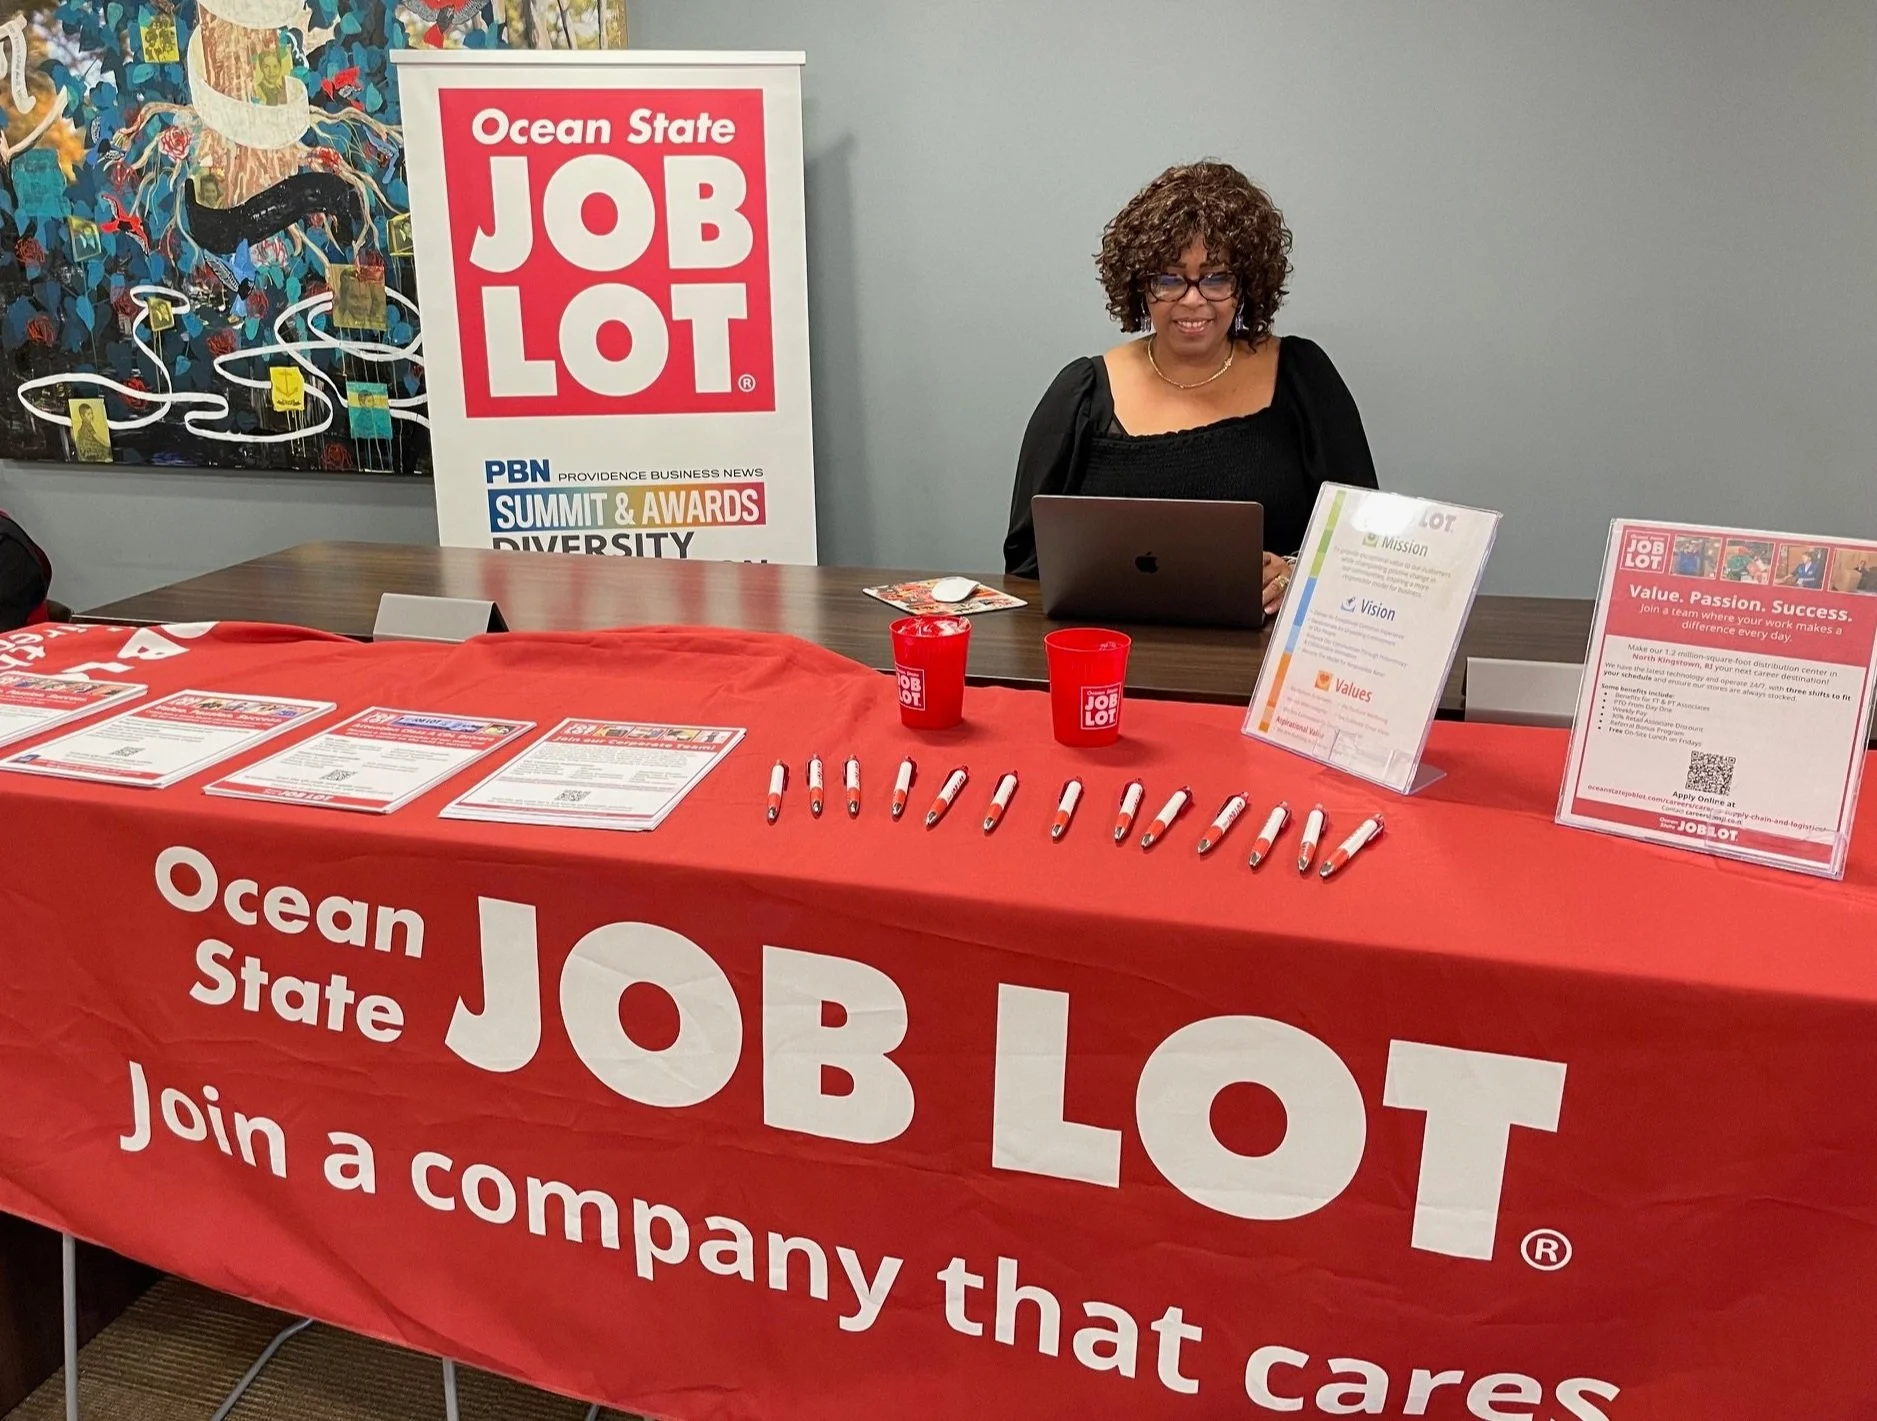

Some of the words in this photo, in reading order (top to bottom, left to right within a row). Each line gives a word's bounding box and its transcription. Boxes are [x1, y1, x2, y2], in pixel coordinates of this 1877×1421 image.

[472, 108, 611, 145] Ocean
[627, 108, 736, 144] State
[470, 154, 754, 273] JOB
[481, 283, 748, 397] LOT
[485, 459, 551, 483] PBN
[558, 471, 647, 482] PROVIDENCE
[650, 469, 720, 480] BUSINESS
[723, 468, 764, 478] NEWS
[495, 493, 607, 529] SUMMIT
[614, 492, 636, 526] &
[642, 488, 760, 526] AWARDS
[1381, 535, 1429, 557] Mission
[1627, 539, 1665, 555] JOB
[1625, 553, 1662, 569] LOT
[1359, 599, 1397, 621] Vision
[1628, 584, 1685, 603] Value.
[1689, 591, 1766, 612] Passion.
[1771, 600, 1854, 622] Success.
[1639, 604, 1660, 615] Join
[1671, 609, 1698, 618] team
[1701, 611, 1735, 623] where
[1737, 617, 1762, 628] your
[1765, 619, 1793, 630] work
[1795, 622, 1833, 635] makes
[1681, 621, 1735, 635] difference
[1738, 629, 1768, 641] every
[1770, 631, 1792, 644] day.
[1632, 654, 1656, 662] North
[1714, 666, 1732, 674] your
[1735, 667, 1751, 675] next
[1753, 671, 1779, 679] career
[1753, 661, 1799, 672] distribution
[1801, 667, 1827, 676] center
[1333, 678, 1373, 703] Values
[1621, 672, 1652, 681] schedule
[1742, 689, 1766, 698] always
[1666, 671, 1703, 682] technology
[1720, 678, 1747, 688] operate
[1786, 687, 1806, 695] three
[1808, 690, 1830, 698] shifts
[1085, 693, 1118, 710] JOB
[1085, 708, 1116, 726] LOT
[1672, 791, 1695, 801] Apply
[1697, 796, 1725, 806] Online
[155, 845, 425, 959] Ocean
[189, 938, 405, 1043] State
[444, 895, 915, 1144] JOB
[991, 982, 1568, 1261] LOT
[119, 1060, 287, 1179] Join
[323, 1131, 376, 1194] a
[411, 1151, 904, 1332] company
[936, 1257, 1203, 1394] that
[1244, 1345, 1621, 1421] cares
